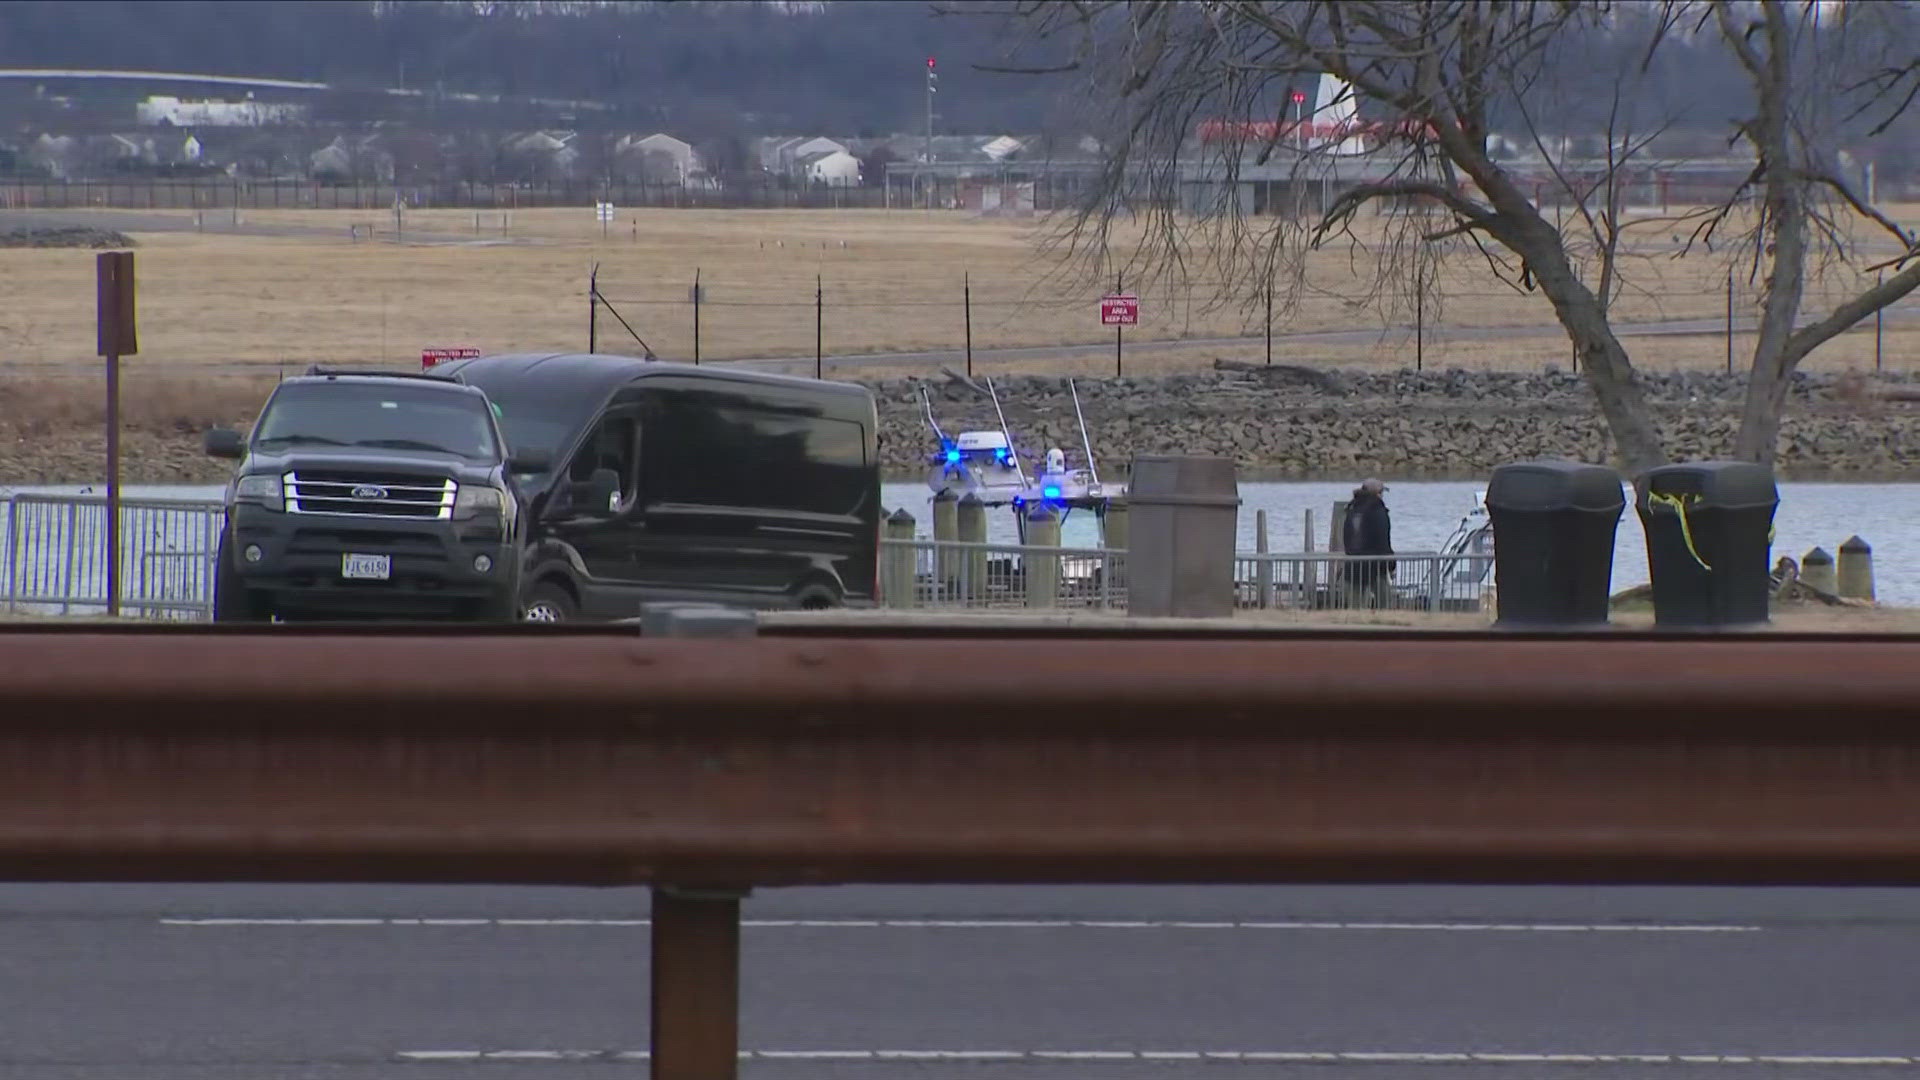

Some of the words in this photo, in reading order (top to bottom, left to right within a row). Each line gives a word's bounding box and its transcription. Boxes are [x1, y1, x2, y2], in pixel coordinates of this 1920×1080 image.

[1111, 306, 1128, 314] AREA
[1104, 314, 1120, 322] KEEP
[1121, 314, 1135, 322] OUT
